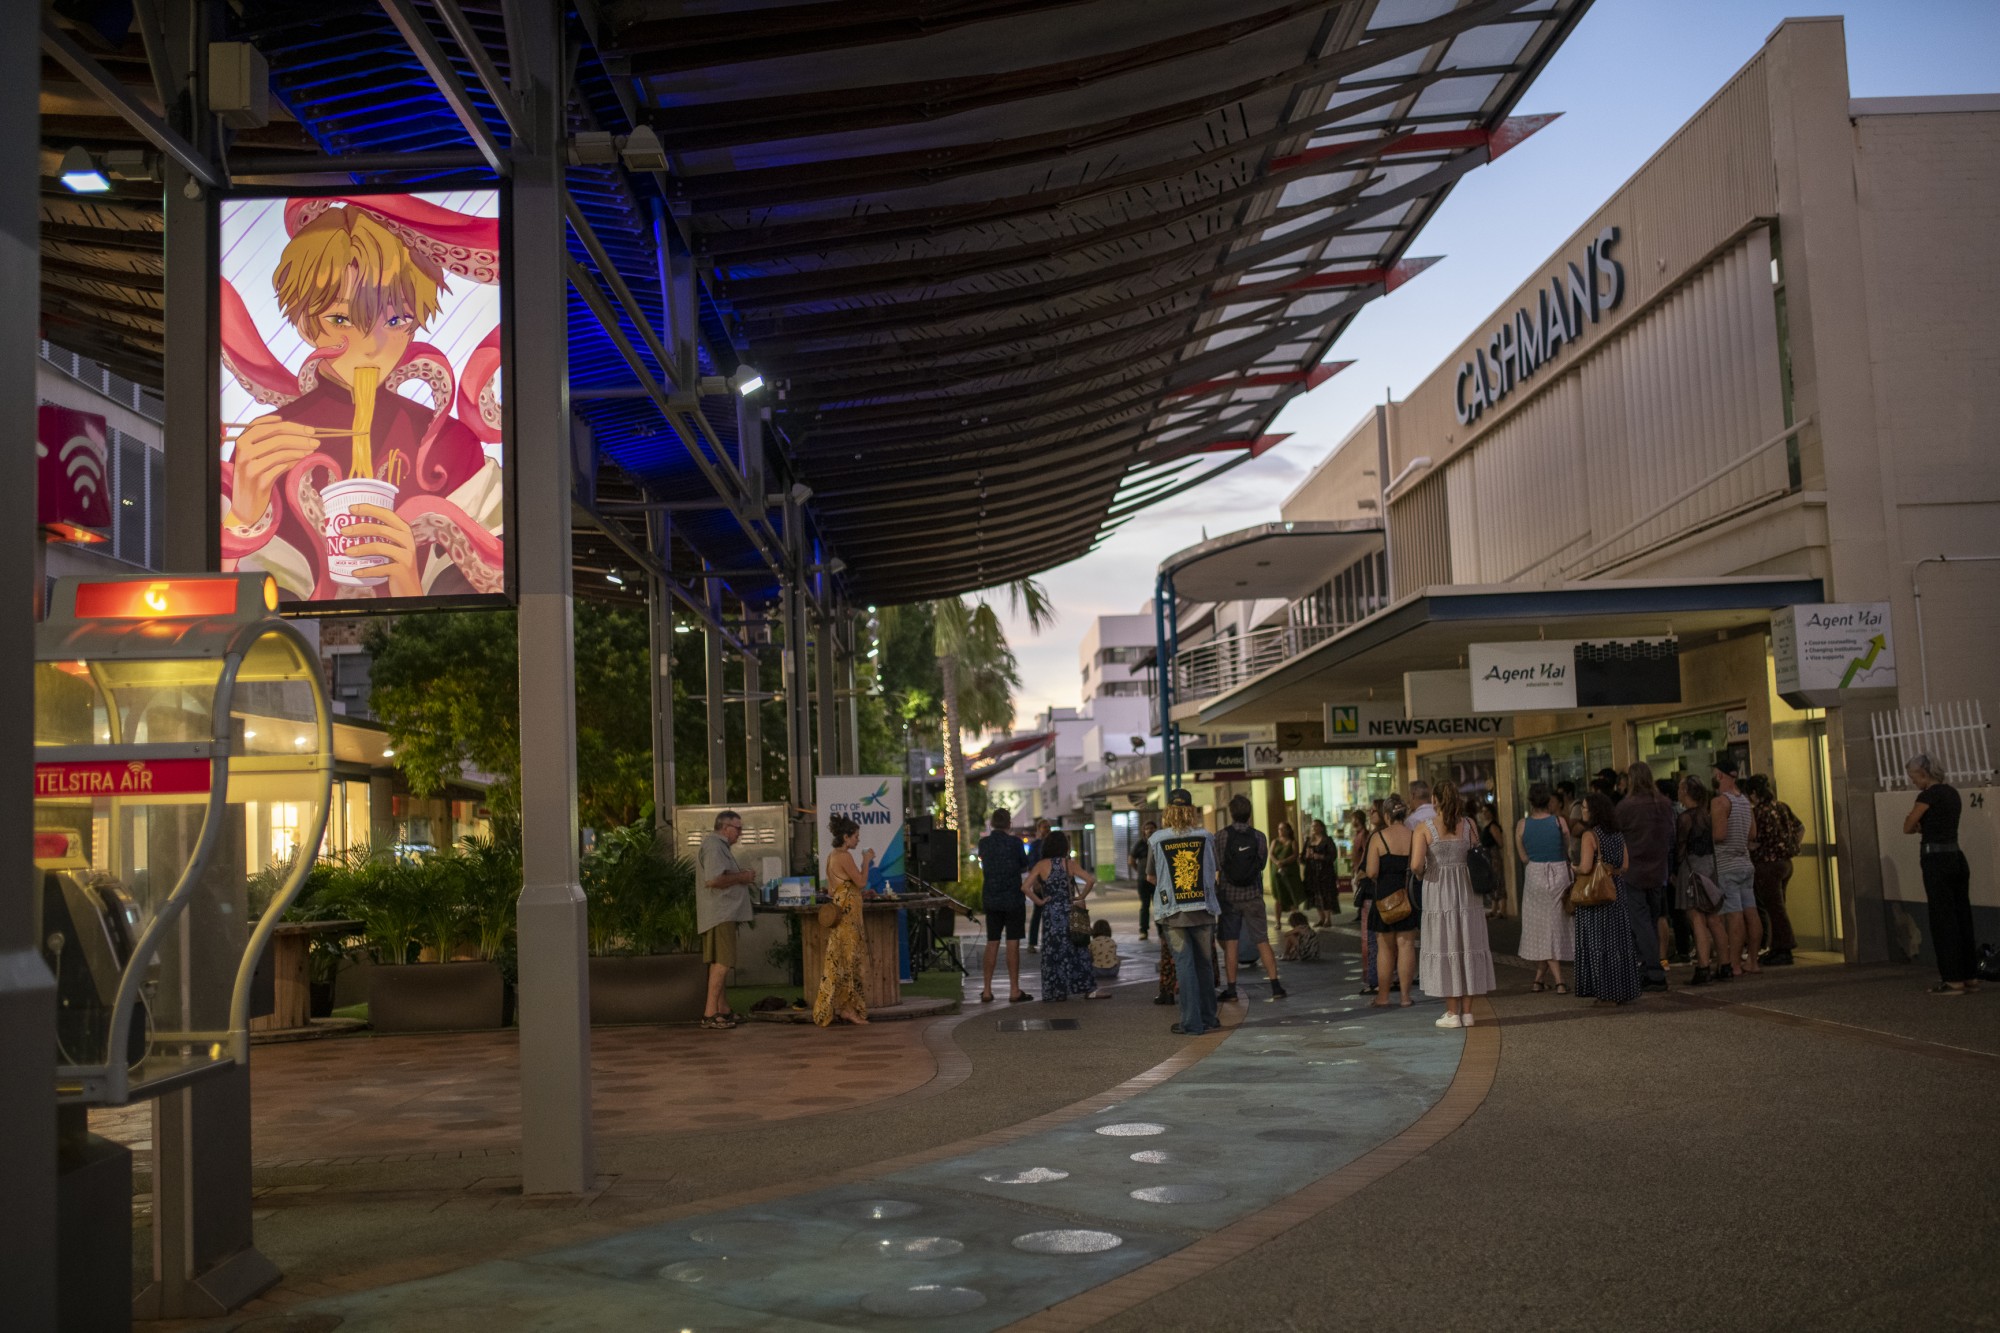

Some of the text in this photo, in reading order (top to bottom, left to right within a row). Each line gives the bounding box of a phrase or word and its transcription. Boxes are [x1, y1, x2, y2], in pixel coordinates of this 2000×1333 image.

[1454, 226, 1624, 426] CASHMAN'S
[1807, 613, 1854, 629] Agent
[1482, 665, 1535, 683] Agent
[1368, 717, 1503, 735] NEWSAGENCY
[37, 771, 114, 792] TELSTRA
[830, 803, 860, 811] CITY OF
[1970, 792, 1984, 809] 24
[1165, 842, 1189, 850] DARWIN
[1175, 891, 1204, 900] TATTOOS
